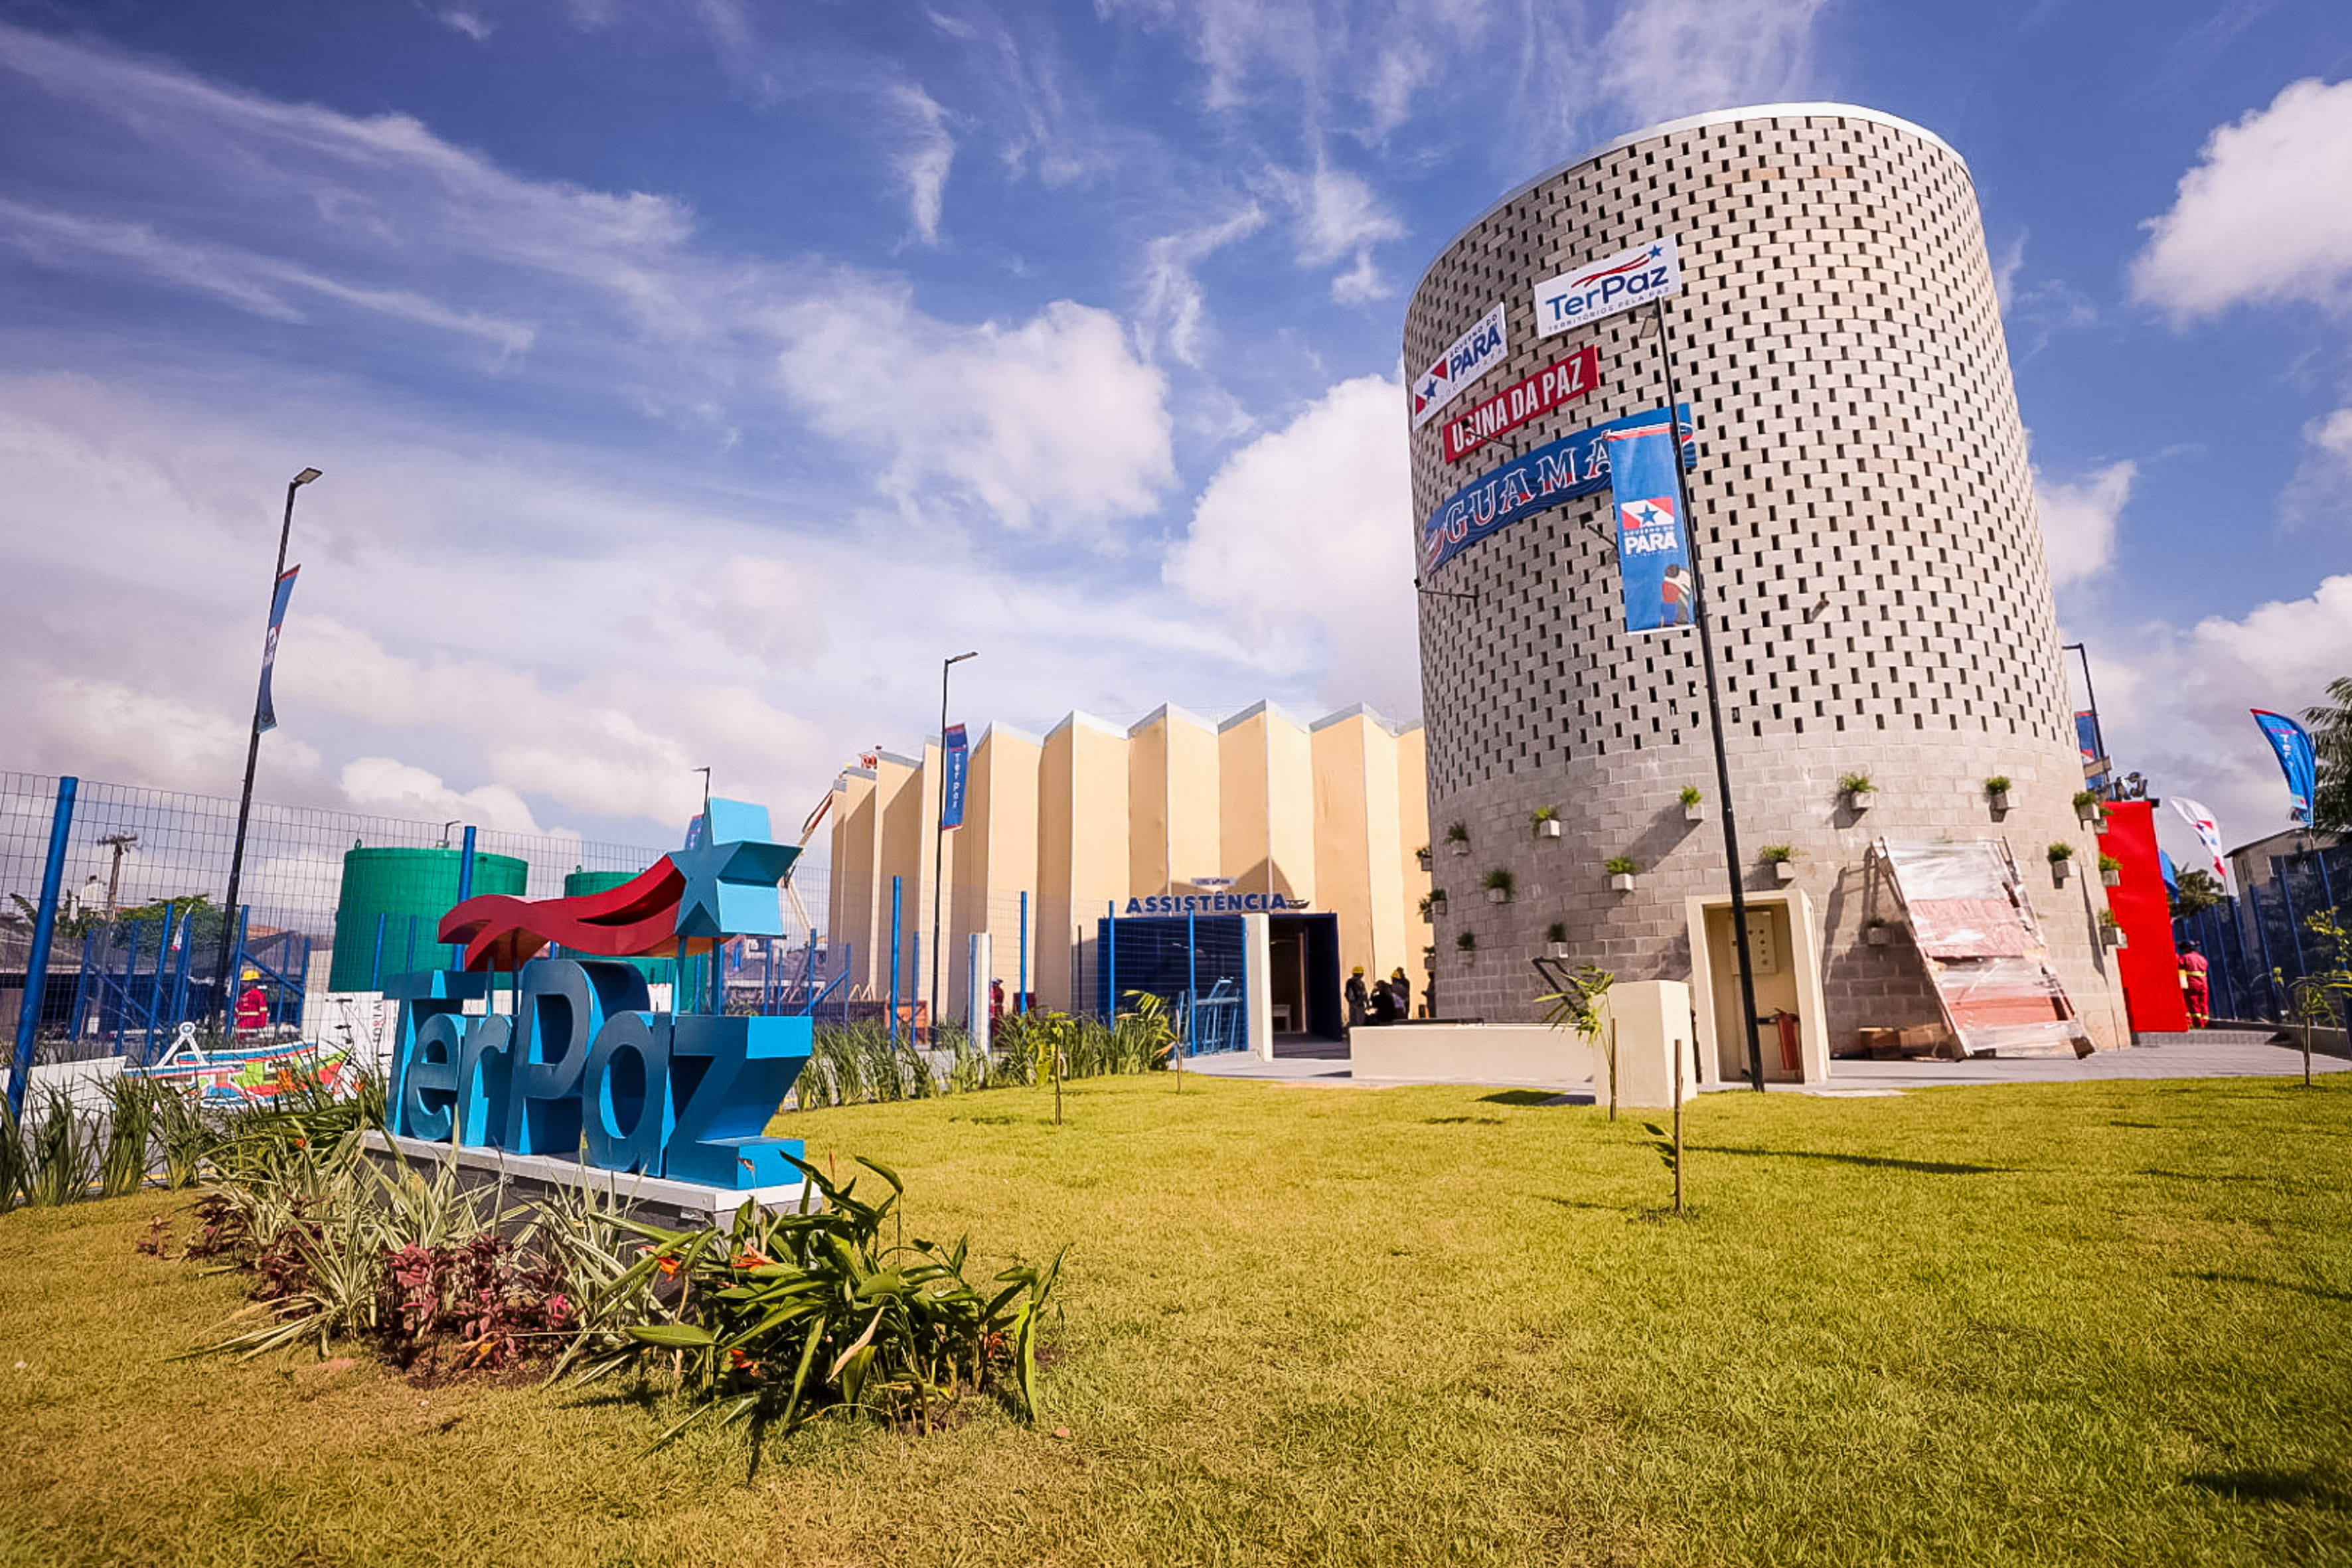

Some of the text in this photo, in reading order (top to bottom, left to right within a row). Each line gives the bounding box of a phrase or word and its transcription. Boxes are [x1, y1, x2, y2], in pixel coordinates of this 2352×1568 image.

[1545, 266, 1669, 321] TerPaz
[1452, 398, 1508, 453] USINA
[1510, 380, 1539, 421] DA
[1542, 356, 1584, 406] PAZ
[1125, 891, 1287, 914] ASSISTÊNCIA
[383, 959, 813, 1190] TerPaz
